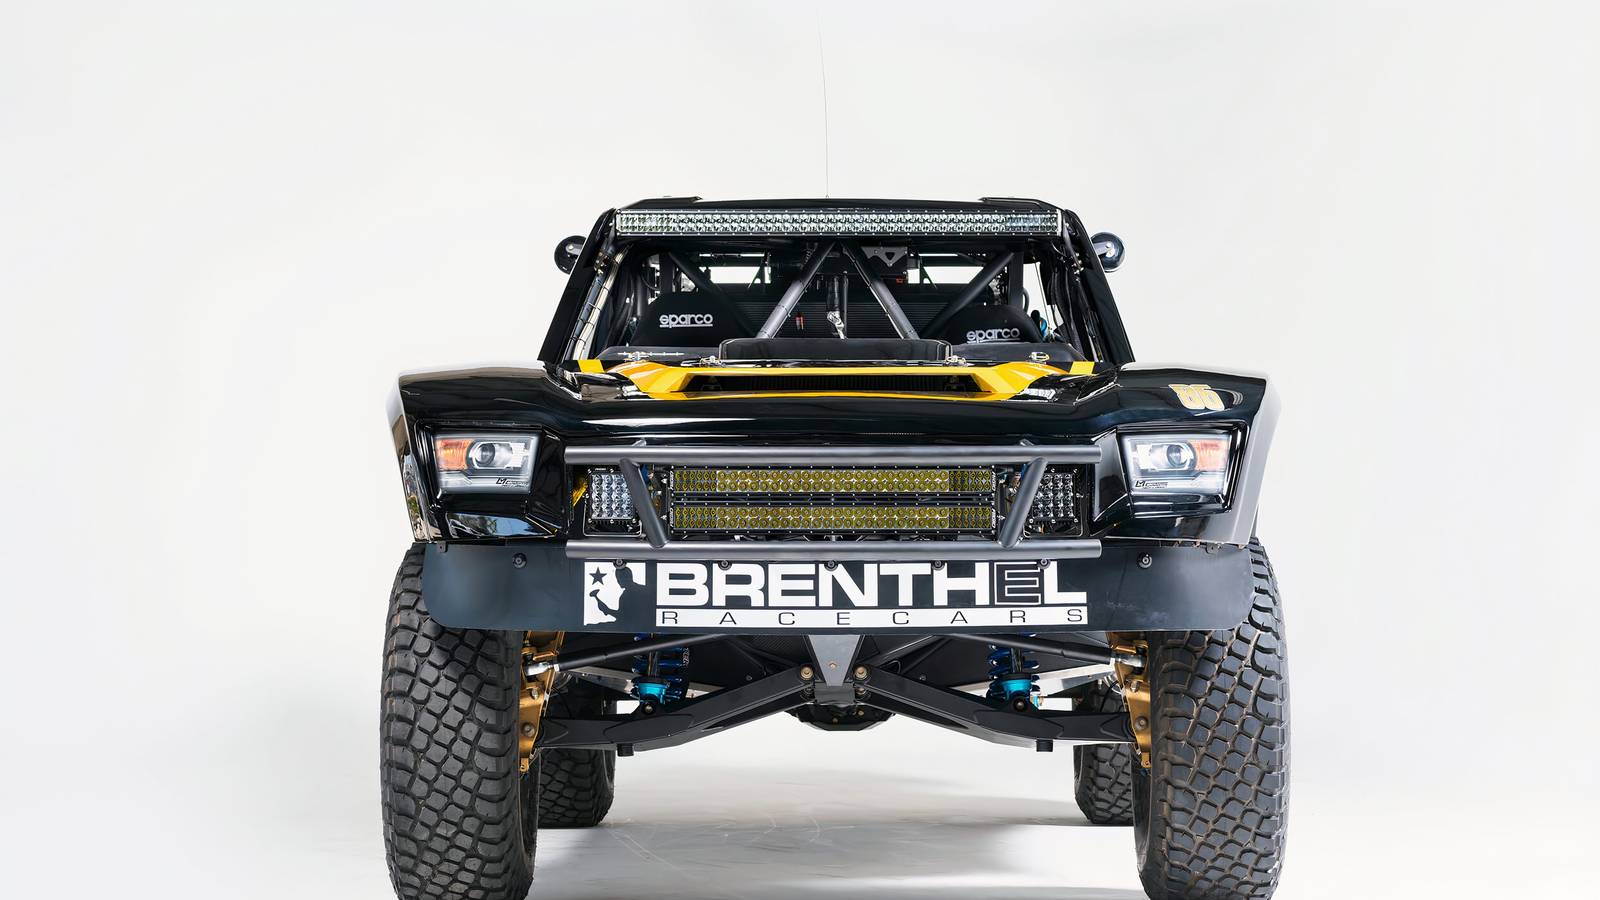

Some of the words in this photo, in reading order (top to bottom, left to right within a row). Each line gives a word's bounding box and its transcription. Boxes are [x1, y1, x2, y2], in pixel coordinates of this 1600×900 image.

[659, 314, 713, 328] sparco
[966, 328, 1020, 344] sparco
[656, 561, 1087, 607] BRENTHEL
[661, 609, 1083, 626] RACECARS
